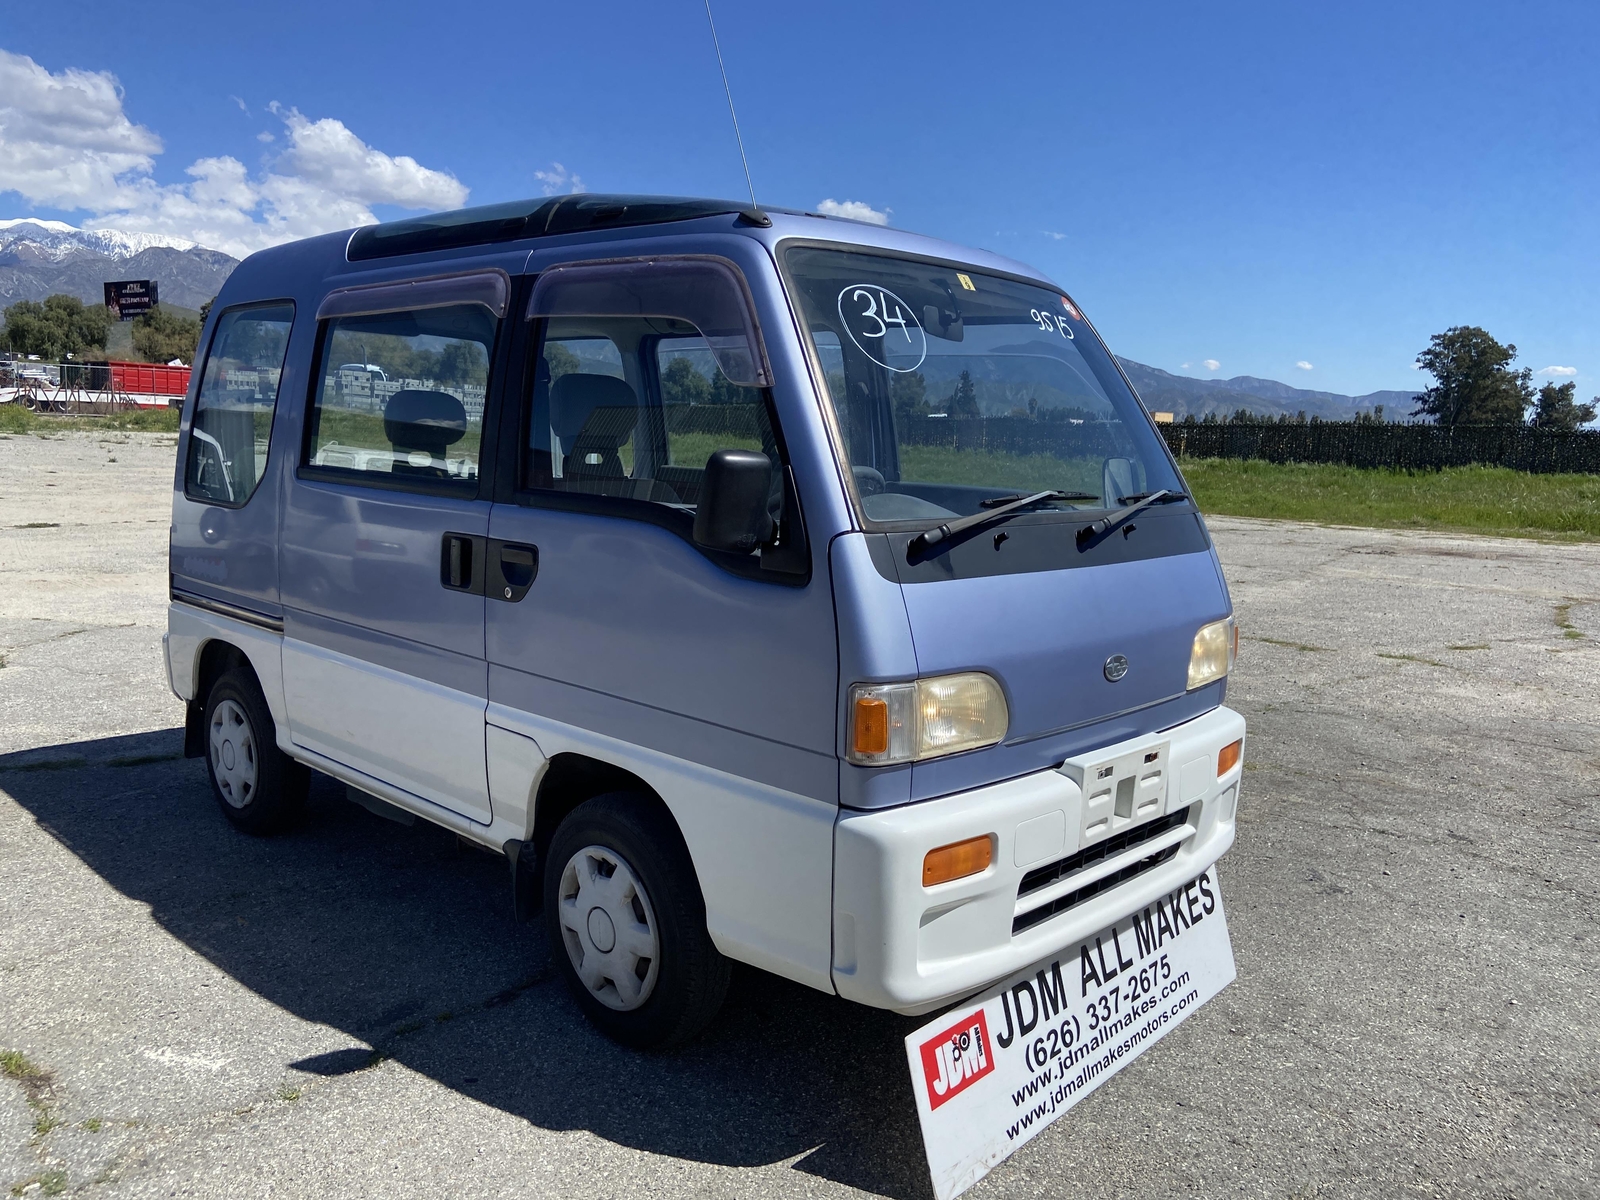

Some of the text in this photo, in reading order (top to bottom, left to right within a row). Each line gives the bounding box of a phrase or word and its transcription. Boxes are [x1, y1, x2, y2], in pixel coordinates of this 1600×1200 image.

[853, 289, 911, 343] 34
[996, 873, 1215, 1049] JDM ALL MAKES
[1025, 953, 1171, 1073] (626) 337-2675
[932, 1023, 987, 1096] JDM
[1006, 989, 1199, 1140] www.jdmallmakesmotors.com
[1011, 971, 1190, 1107] www.jdmallmakes.com
